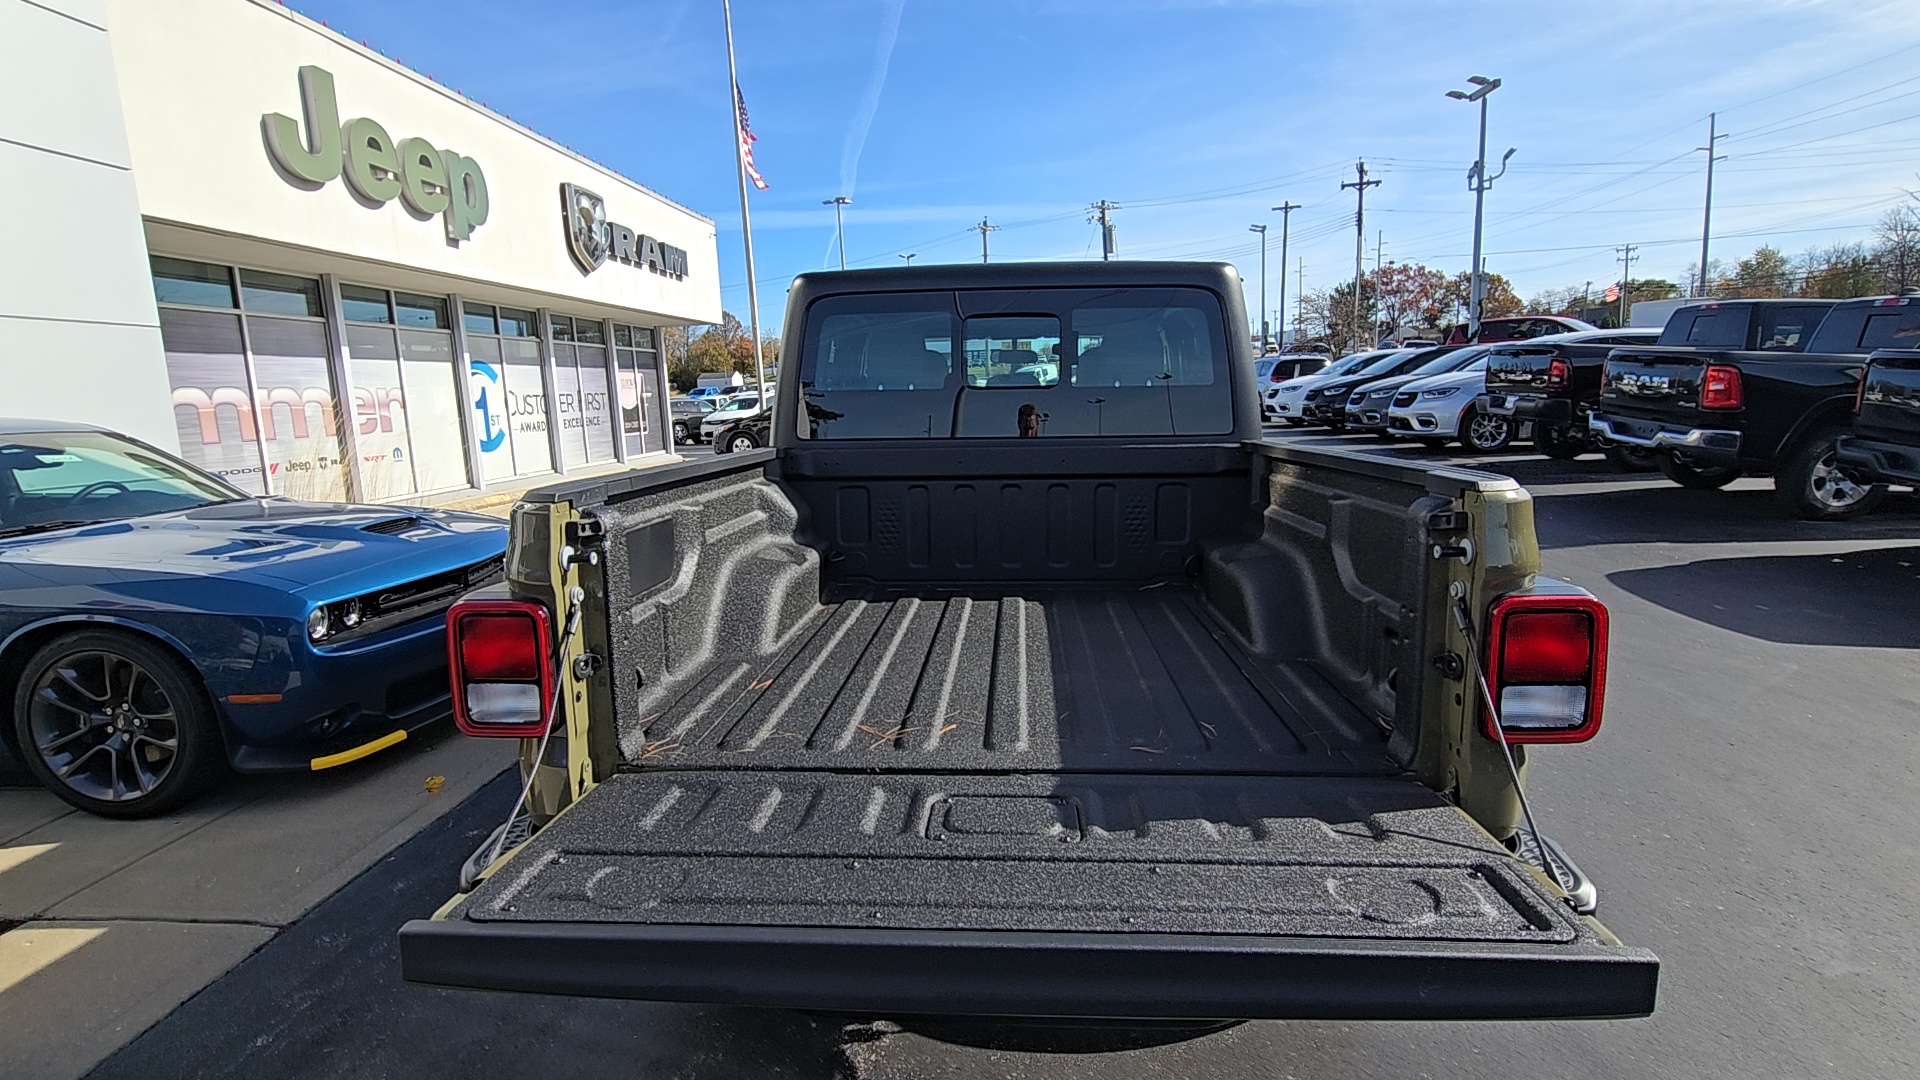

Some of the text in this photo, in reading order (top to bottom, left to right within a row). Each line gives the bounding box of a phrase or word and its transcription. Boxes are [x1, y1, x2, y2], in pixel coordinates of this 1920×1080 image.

[260, 65, 489, 244] Jeep
[606, 222, 689, 278] RAM
[1622, 374, 1670, 388] RAM
[520, 416, 601, 433] AWARD EXCELENCE
[218, 455, 387, 476] DODG Jeep SRT
